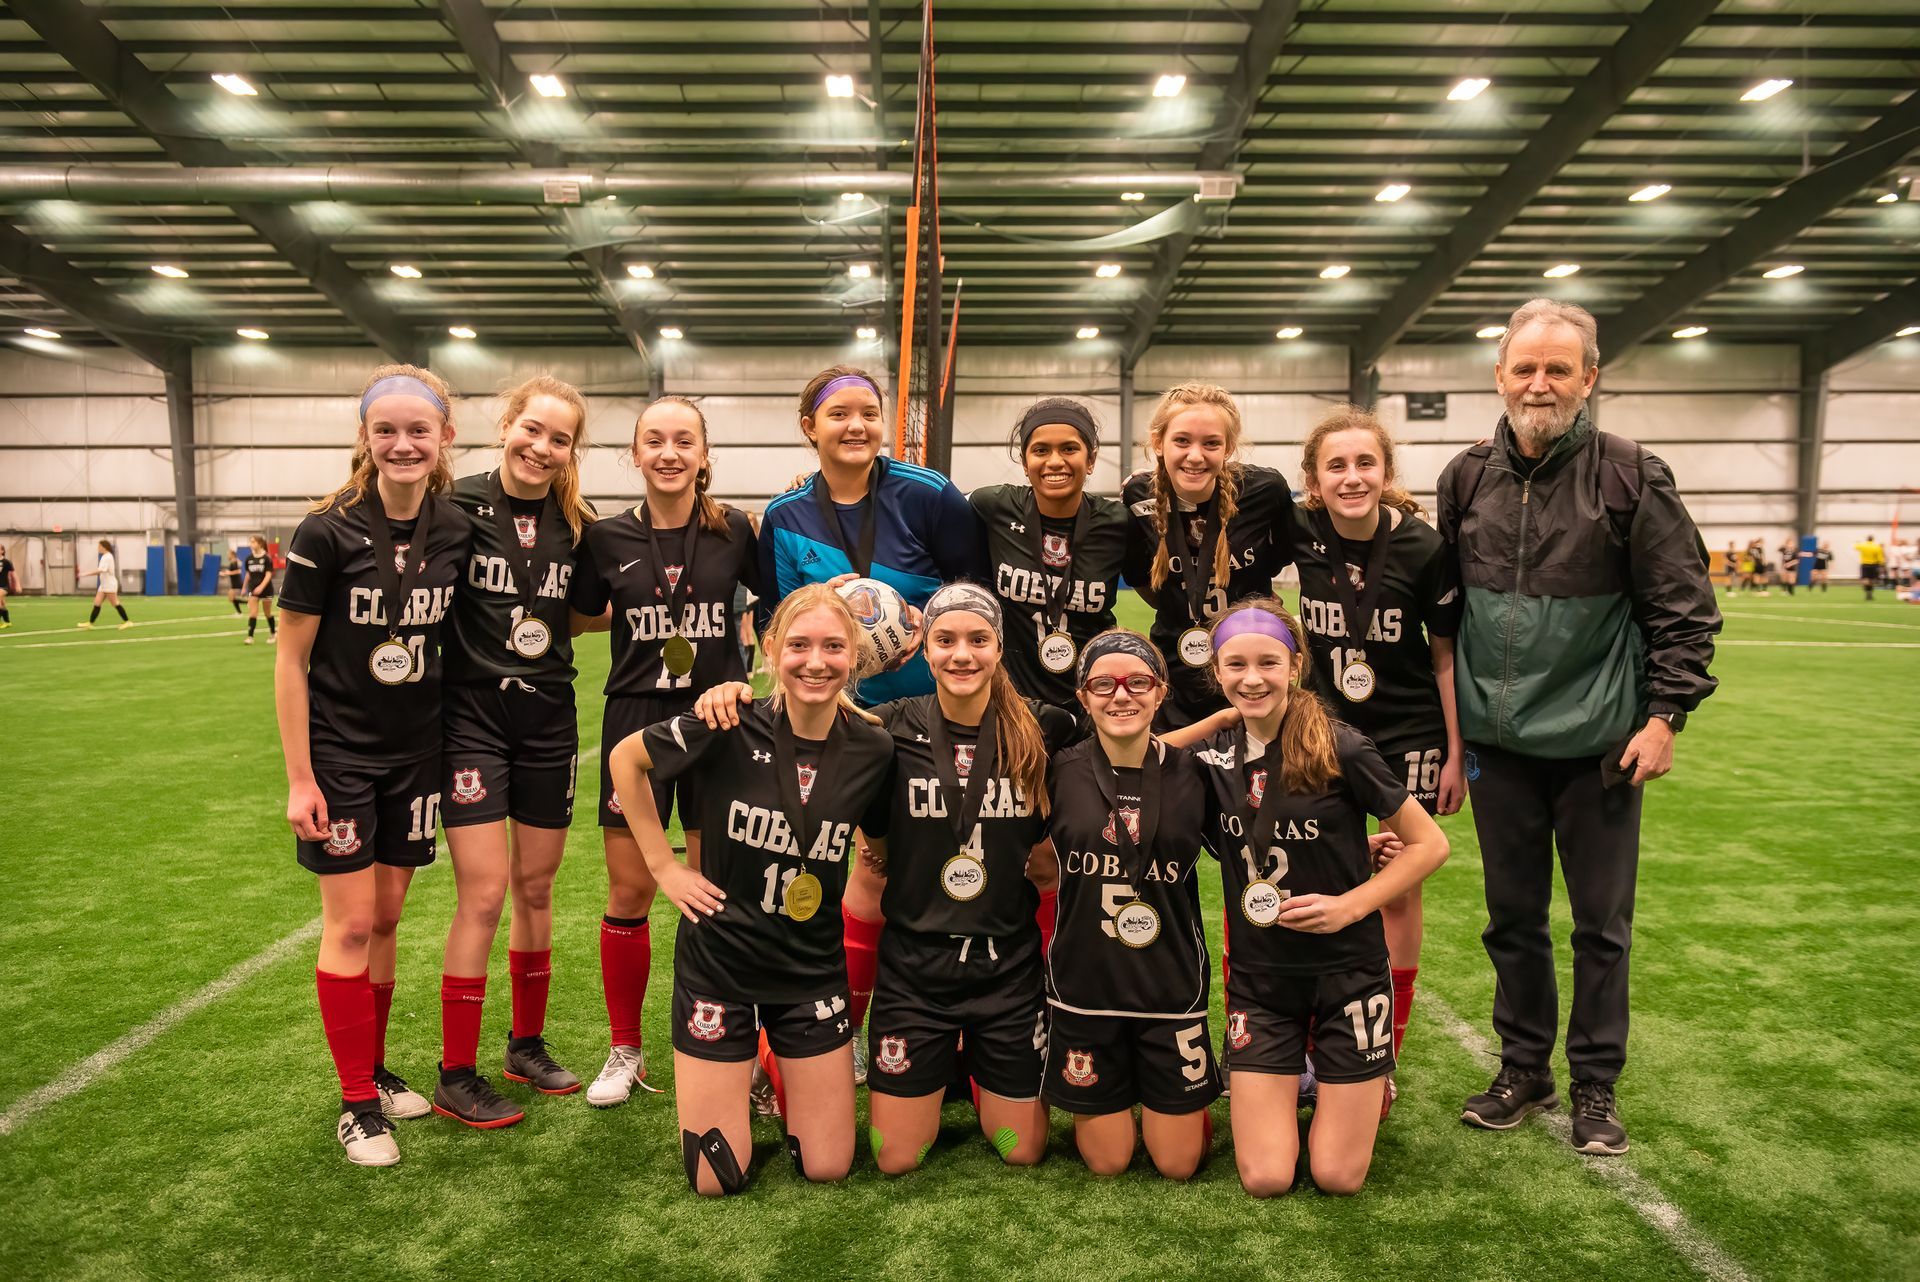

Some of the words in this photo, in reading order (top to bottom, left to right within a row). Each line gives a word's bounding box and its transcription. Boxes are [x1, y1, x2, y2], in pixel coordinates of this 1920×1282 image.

[885, 625, 902, 650] NCAA
[1301, 595, 1403, 643] COBAS
[871, 632, 889, 663] Wilson
[1404, 748, 1442, 792] 16
[407, 792, 441, 841] 10
[908, 777, 1035, 818] CORAS
[959, 822, 985, 864] 4
[1220, 812, 1320, 841] CORAS
[1066, 850, 1180, 884] COBAS
[1240, 844, 1291, 899] 12
[1100, 883, 1136, 939] 5
[696, 1020, 717, 1029] COBRAS
[1343, 993, 1392, 1051] 12
[1175, 1022, 1208, 1082] 5
[710, 1141, 720, 1153] KT
